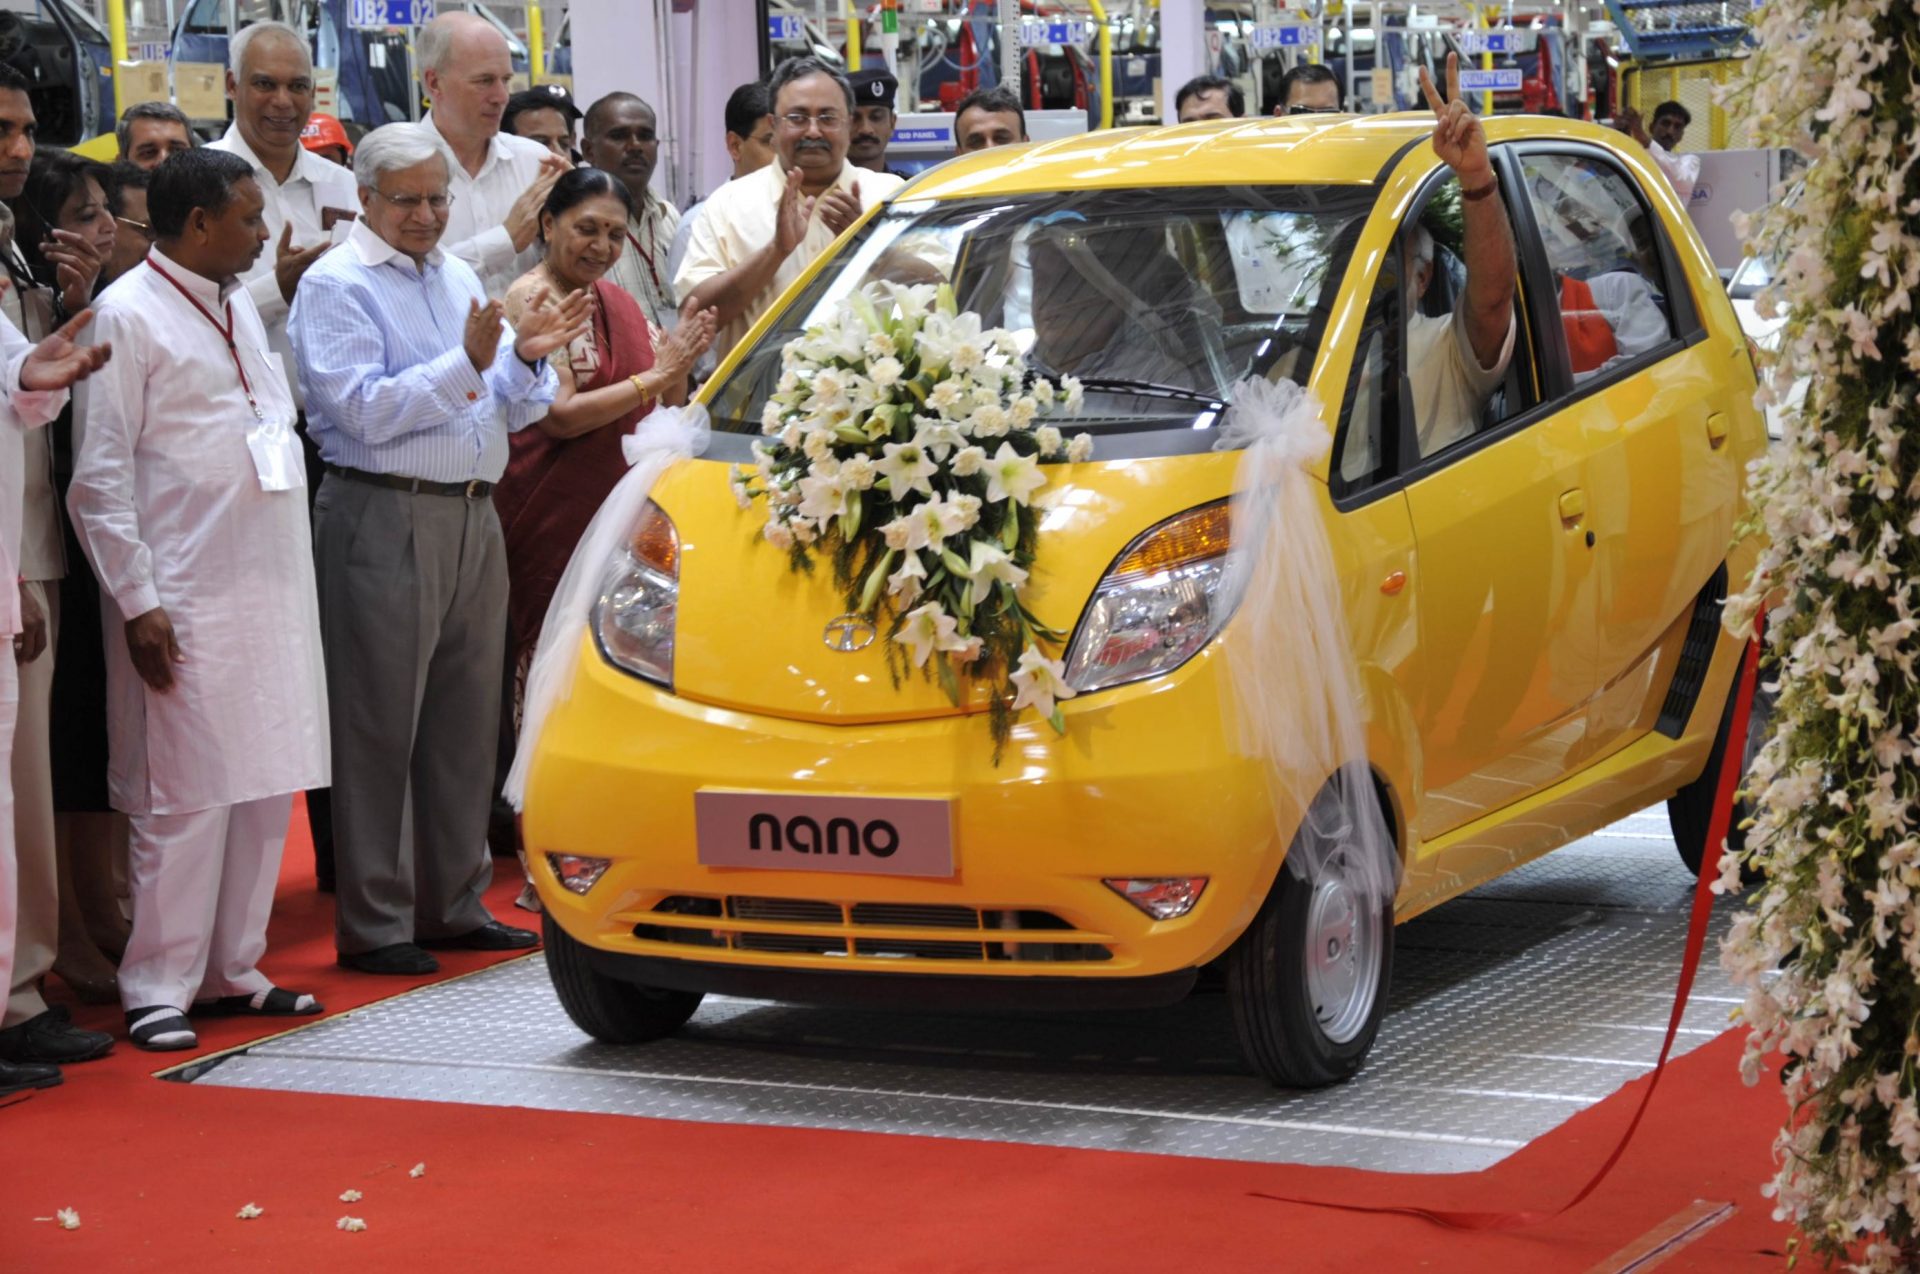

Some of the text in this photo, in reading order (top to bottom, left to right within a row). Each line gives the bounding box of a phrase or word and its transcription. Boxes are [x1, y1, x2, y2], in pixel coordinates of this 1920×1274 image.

[351, 0, 434, 23] UB2 02
[782, 16, 801, 38] 03
[1021, 23, 1050, 44] UB2
[1253, 27, 1281, 47] UB2
[1461, 33, 1488, 54] UB2
[912, 131, 937, 139] PANEL
[749, 813, 899, 858] nano
